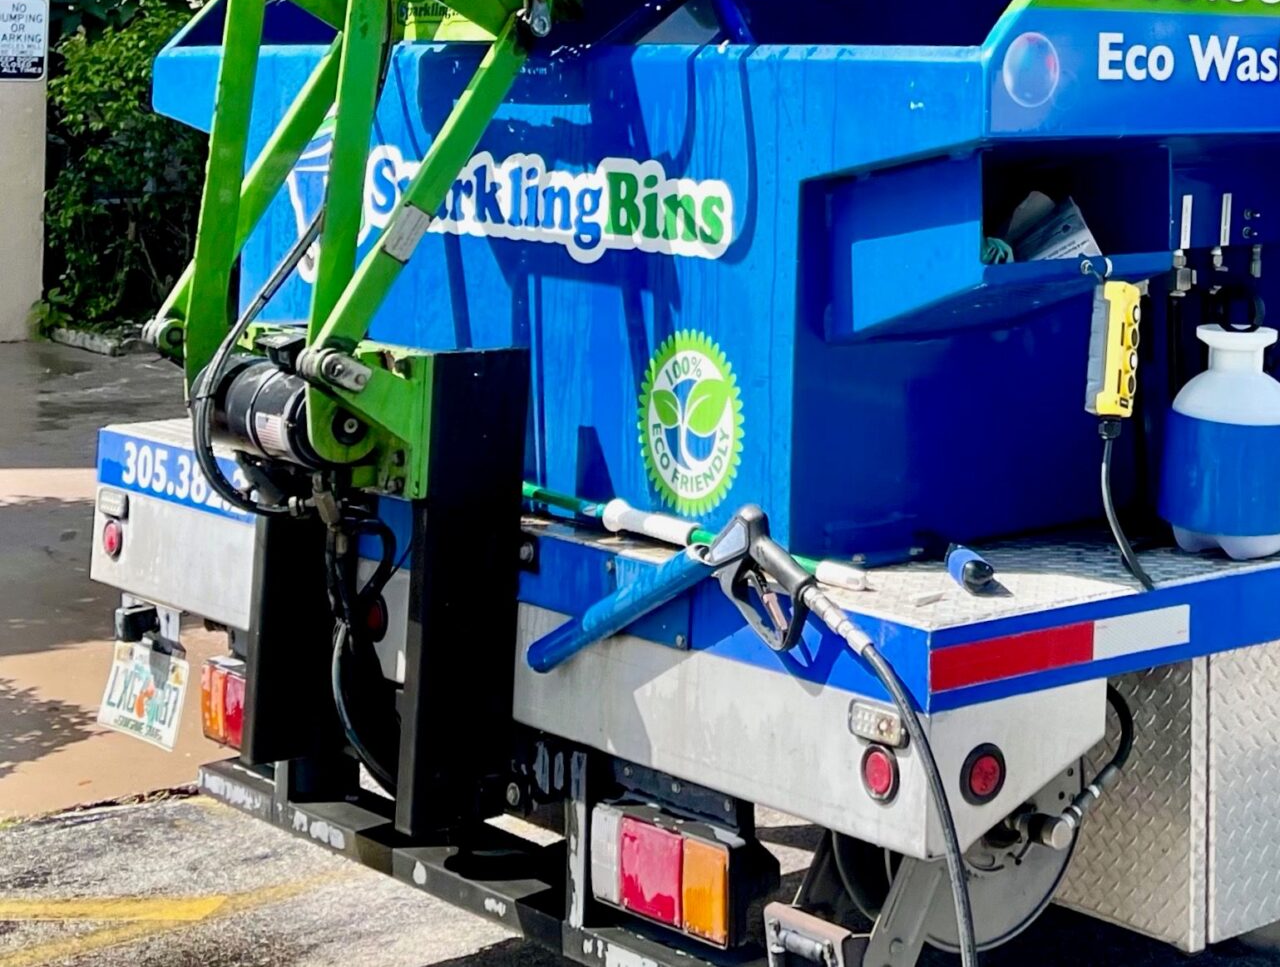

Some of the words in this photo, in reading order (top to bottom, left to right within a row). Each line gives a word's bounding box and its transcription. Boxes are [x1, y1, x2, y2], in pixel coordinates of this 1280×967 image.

[12, 3, 27, 13] NO
[0, 14, 43, 23] UMPING
[10, 23, 25, 33] OR
[0, 34, 42, 44] ARKING
[1098, 32, 1174, 80] Eco
[371, 158, 725, 249] SrklingBins
[664, 356, 702, 385] 100%
[652, 423, 670, 470] ECO
[671, 427, 730, 493] FRIENDLY
